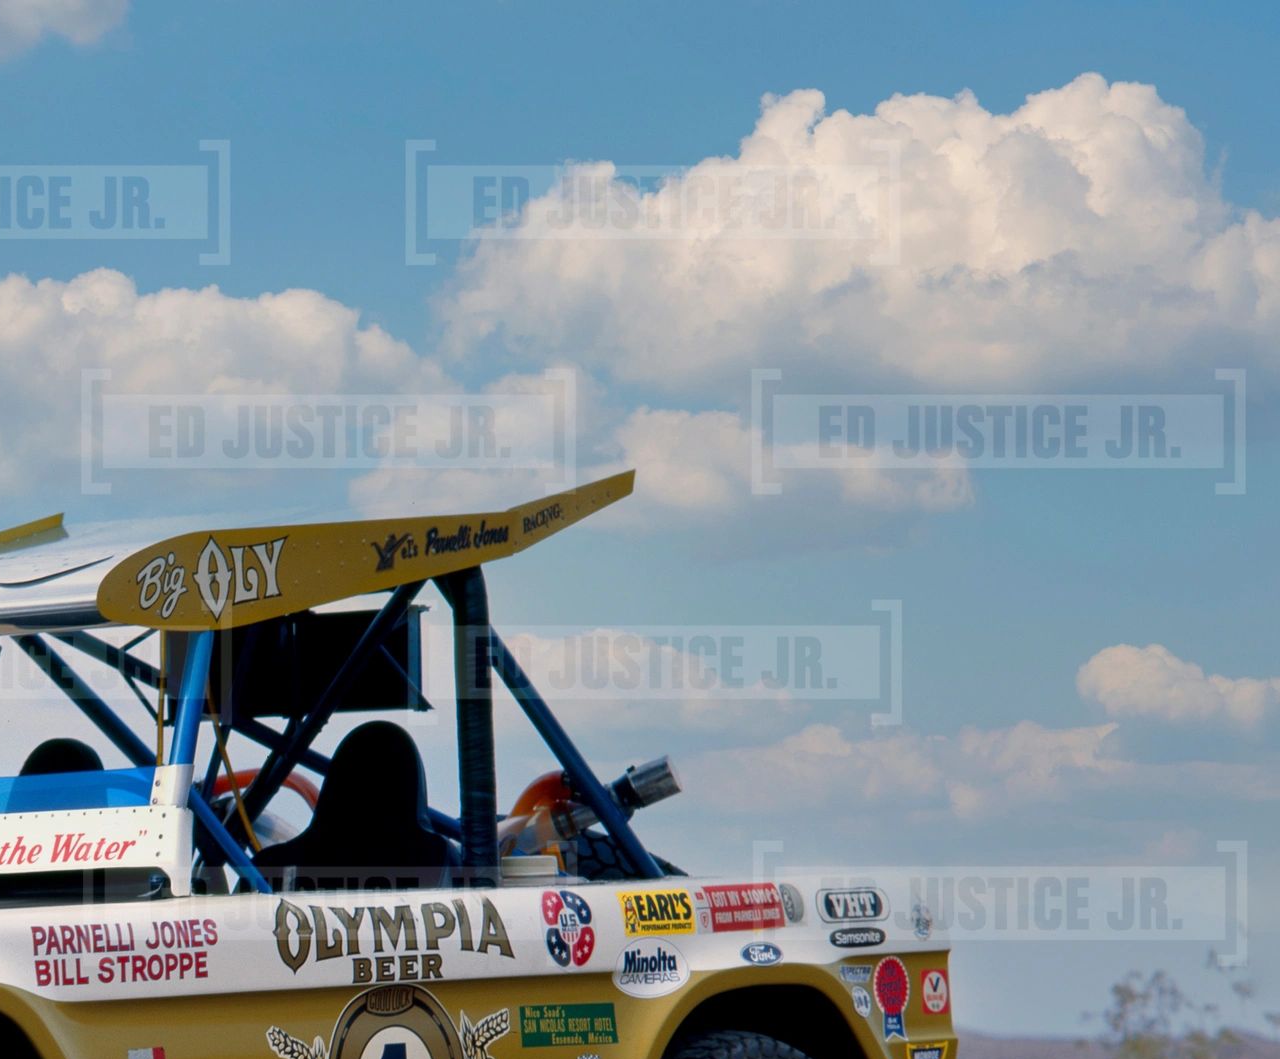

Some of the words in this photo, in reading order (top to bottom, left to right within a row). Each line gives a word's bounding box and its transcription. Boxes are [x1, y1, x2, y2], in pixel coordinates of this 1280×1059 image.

[425, 526, 471, 556] Parnelli
[474, 520, 509, 549] Jones
[136, 551, 188, 619] Big
[192, 534, 289, 622] OLY
[634, 892, 692, 921] EARL'S
[829, 893, 876, 917] VHT
[31, 922, 135, 956] PARNELLI
[146, 918, 219, 950] JONES
[272, 896, 515, 975] OLYMPIA
[835, 932, 881, 945] Samsonite
[352, 953, 443, 984] BEER
[623, 947, 677, 974] Minolta
[749, 946, 776, 962] Ford
[34, 955, 90, 987] BILL
[97, 951, 209, 984] STROPPE
[620, 973, 681, 985] CAMERAS
[524, 1020, 537, 1033] SAN
[568, 1018, 590, 1032] RESORT
[594, 1017, 613, 1031] HOTEL
